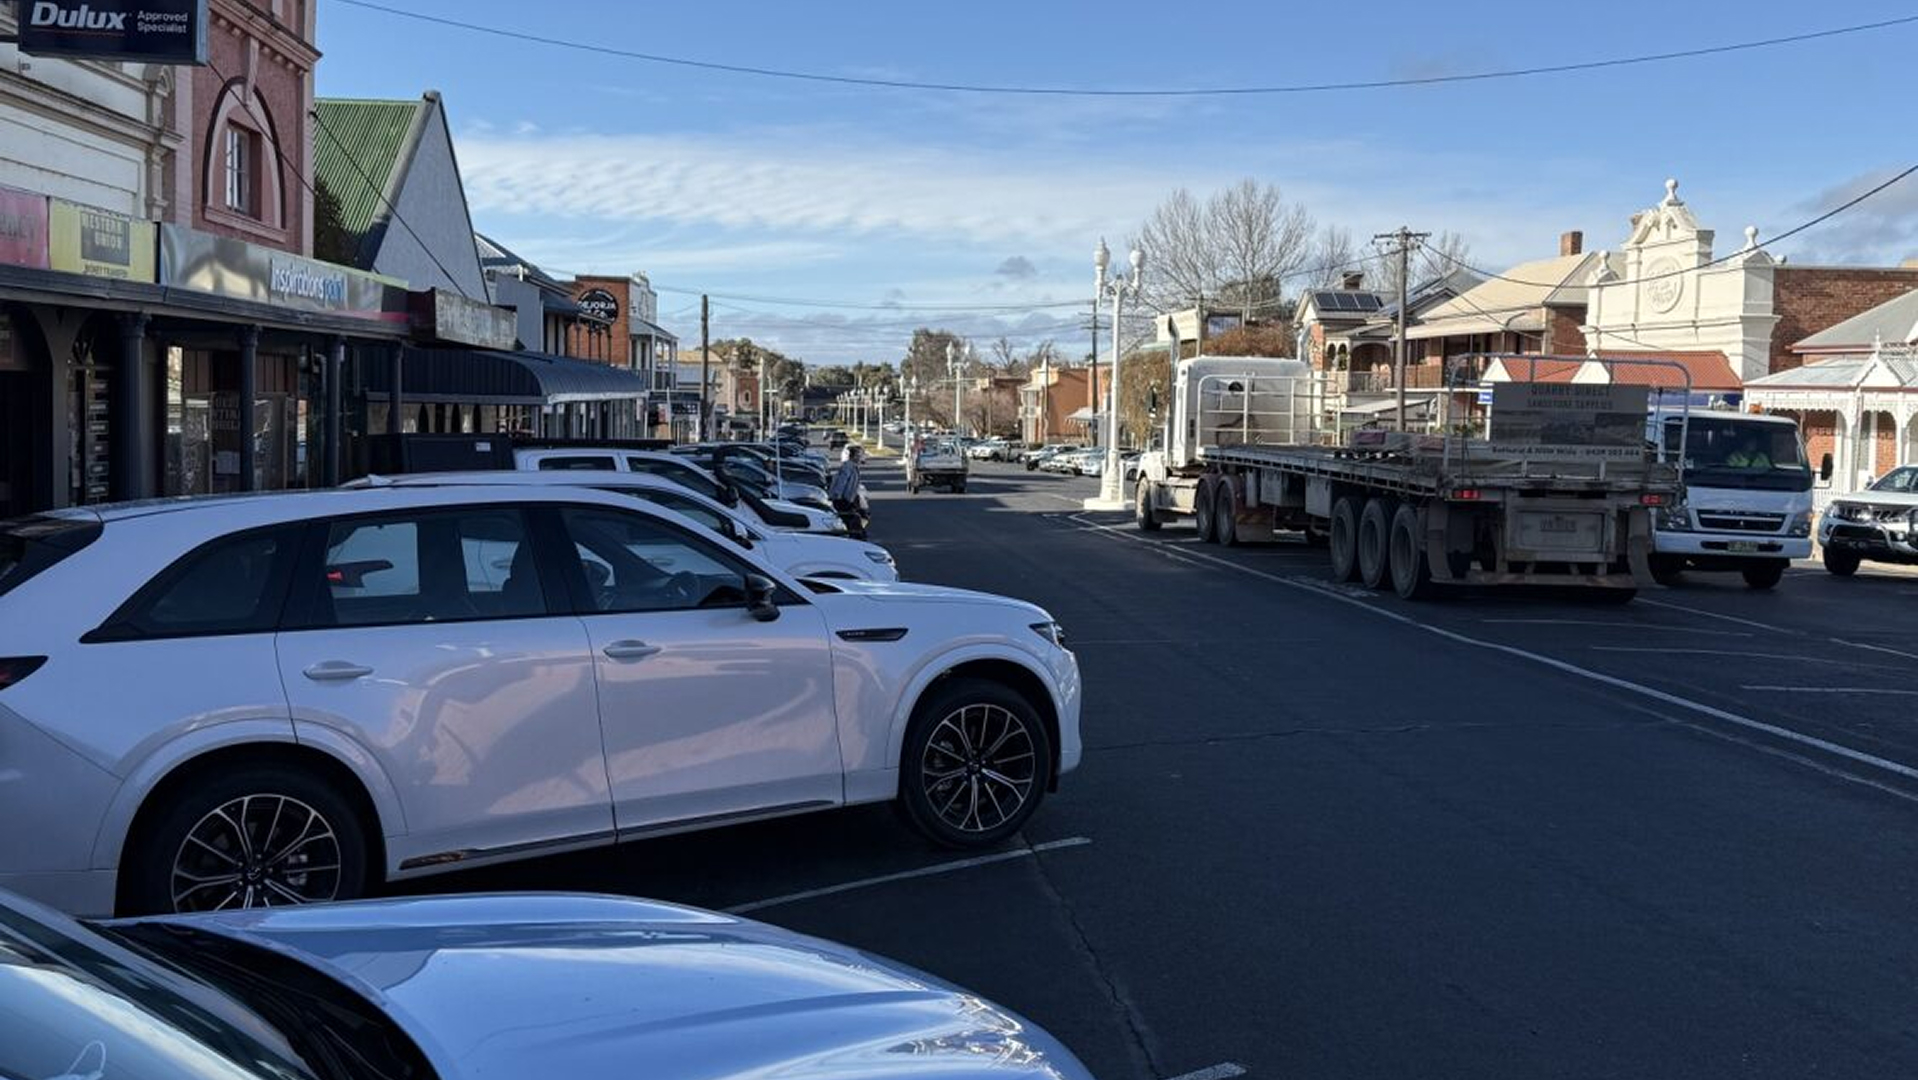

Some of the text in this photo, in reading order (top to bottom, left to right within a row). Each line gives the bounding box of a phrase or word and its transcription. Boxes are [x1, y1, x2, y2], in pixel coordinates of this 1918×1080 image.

[30, 1, 127, 30] Dulux
[137, 10, 188, 22] Approved
[137, 22, 187, 33] Specialist
[82, 213, 123, 234] WESTERN
[94, 231, 123, 251] UNION
[1531, 385, 1610, 397] QUARRY DIRECT
